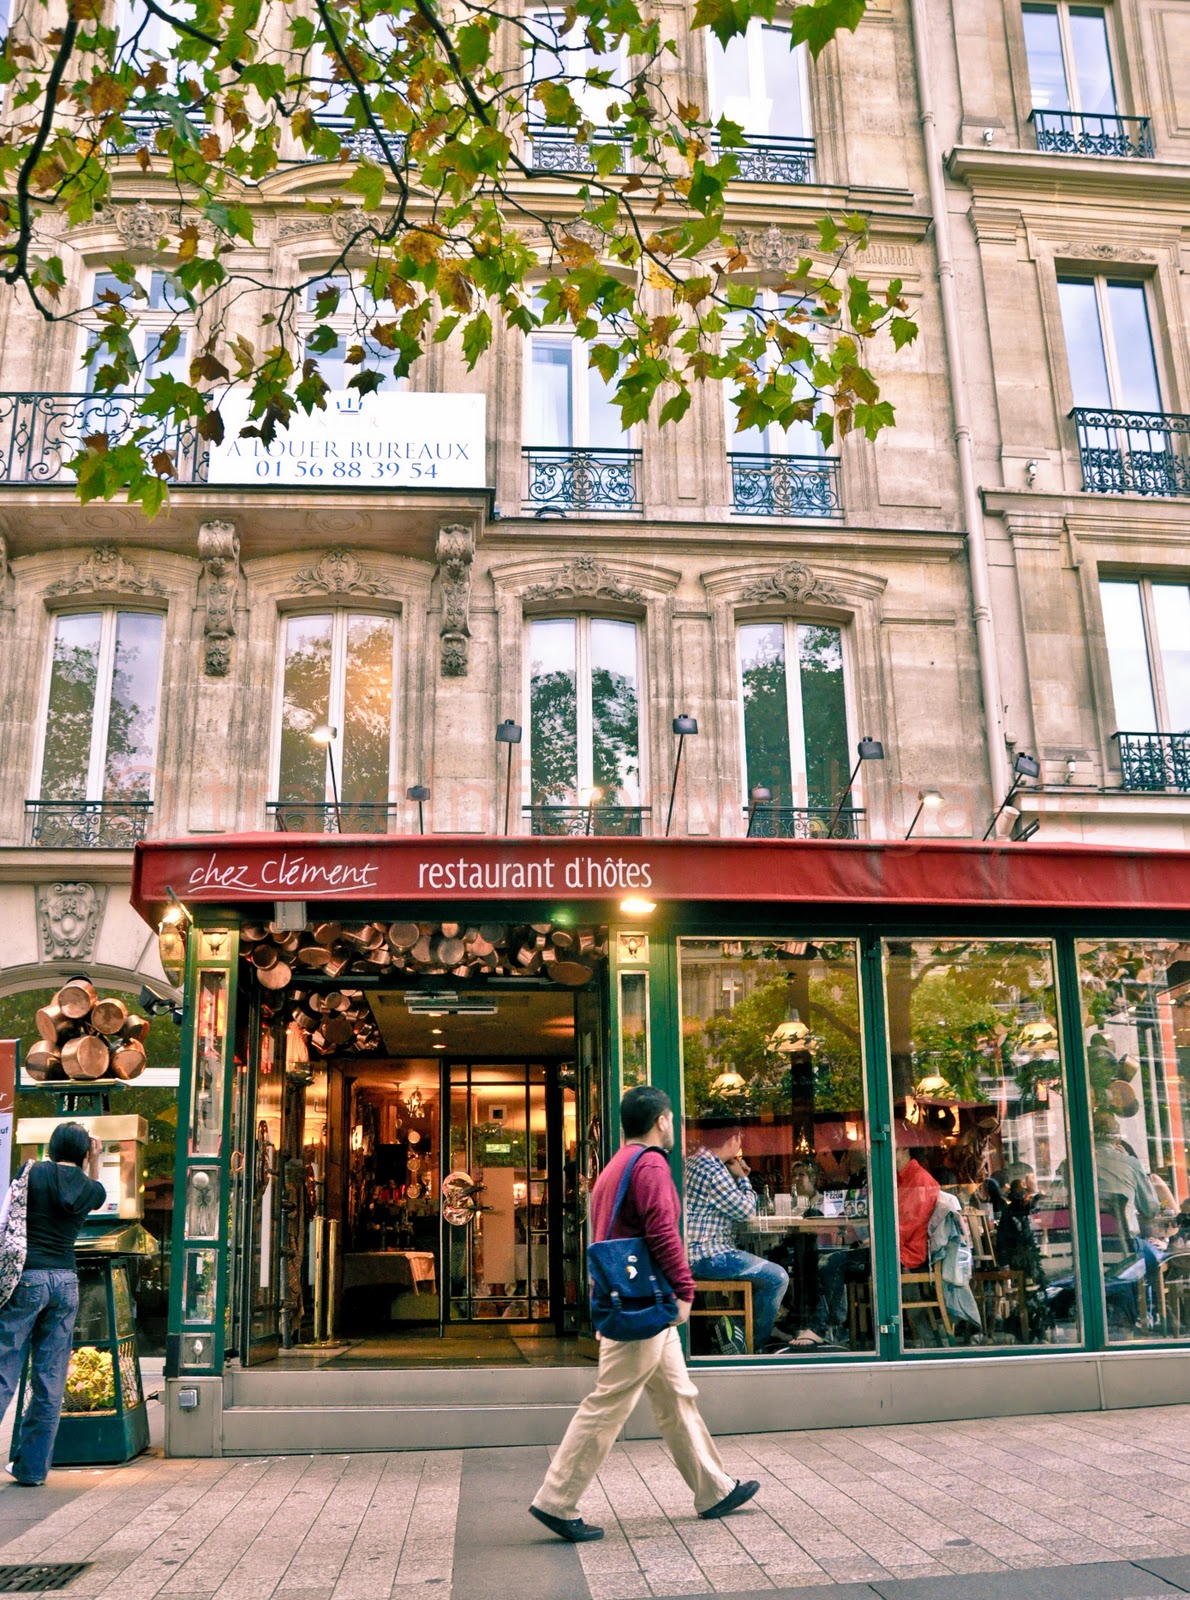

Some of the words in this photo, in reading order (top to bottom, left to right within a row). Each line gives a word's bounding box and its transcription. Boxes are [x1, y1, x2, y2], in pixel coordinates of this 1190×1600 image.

[227, 440, 241, 457] A
[254, 440, 339, 458] LOUER
[350, 441, 469, 460] BUREAUX
[256, 460, 281, 477] 01
[295, 461, 323, 478] 56
[332, 461, 362, 478] 88
[371, 462, 400, 478] 39
[410, 463, 438, 479] 54
[189, 853, 257, 887] chez
[261, 853, 379, 885] Clément
[418, 857, 555, 888] restaurant
[565, 857, 653, 888] d'hôtes
